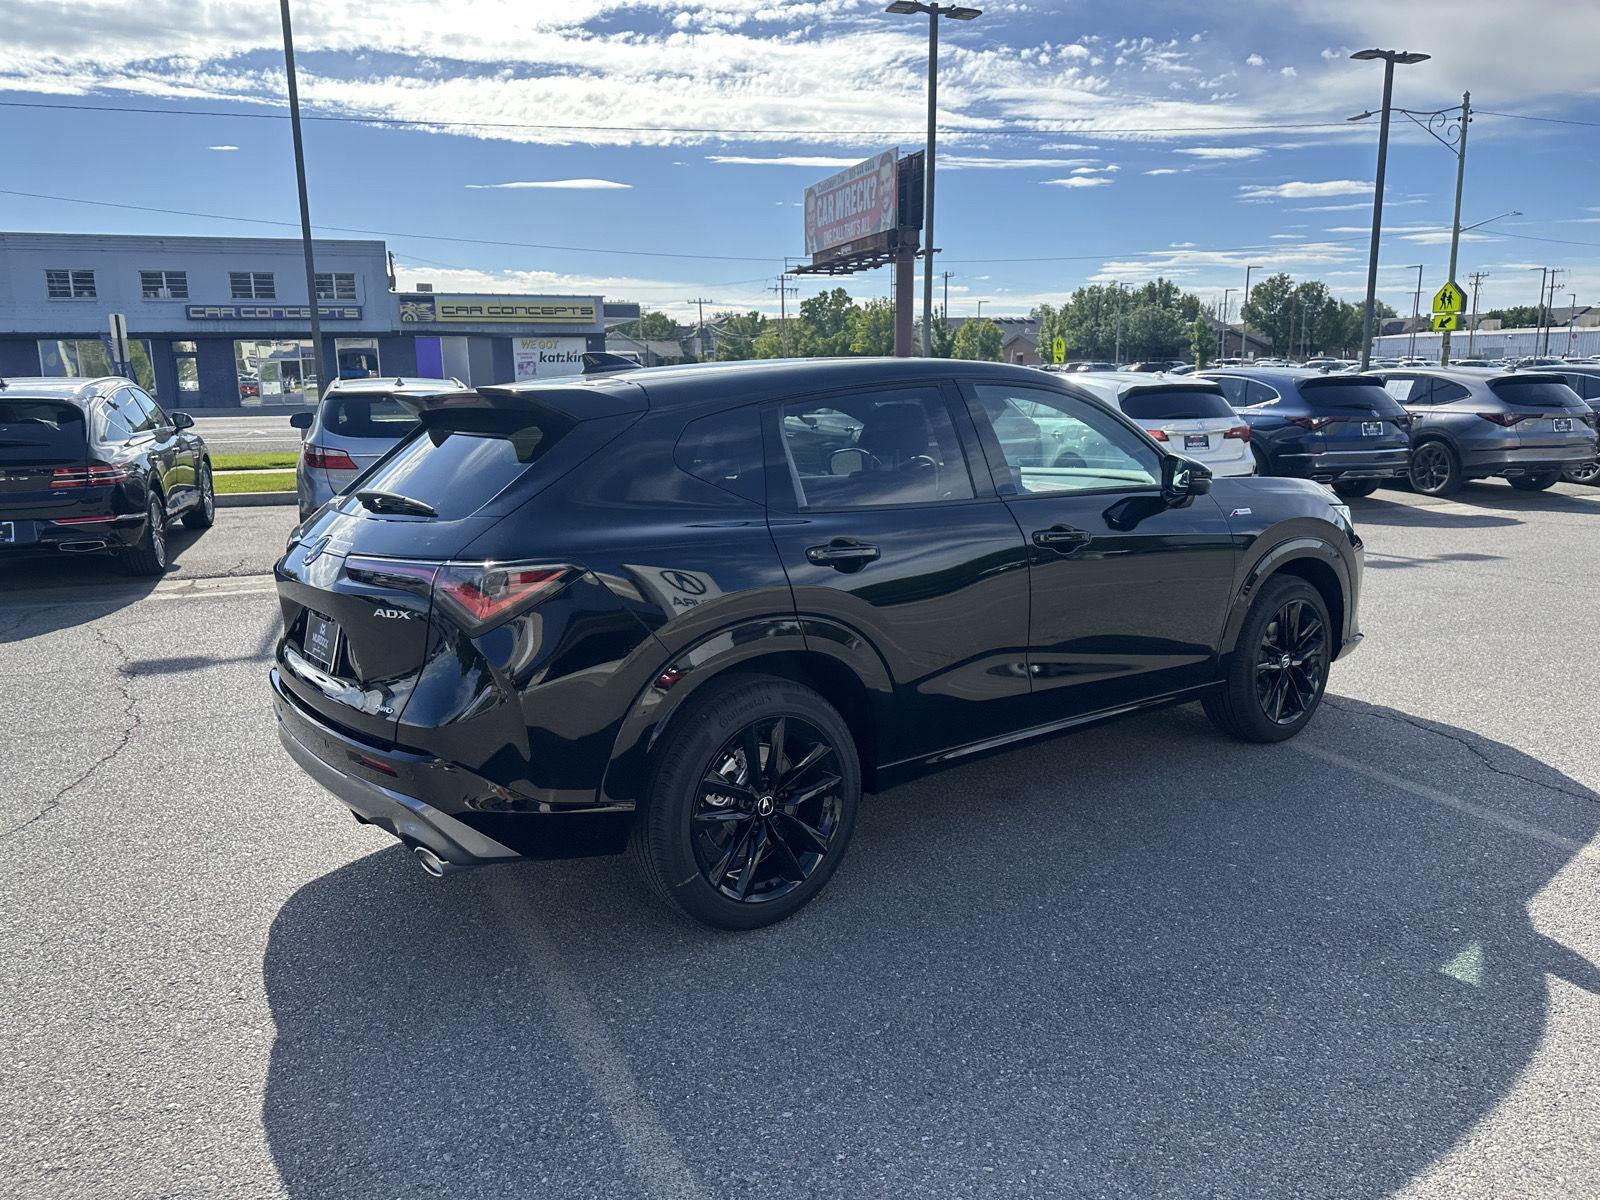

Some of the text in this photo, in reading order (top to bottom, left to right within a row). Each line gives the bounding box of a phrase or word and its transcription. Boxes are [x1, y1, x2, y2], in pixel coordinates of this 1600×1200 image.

[817, 194, 834, 228] CAR
[836, 175, 878, 220] WRECK?
[189, 307, 359, 318] CAR CONCEPTS
[441, 305, 594, 315] CAR CONCEPTS
[520, 339, 537, 350] WE
[373, 608, 411, 620] ADX
[374, 704, 394, 714] AWD
